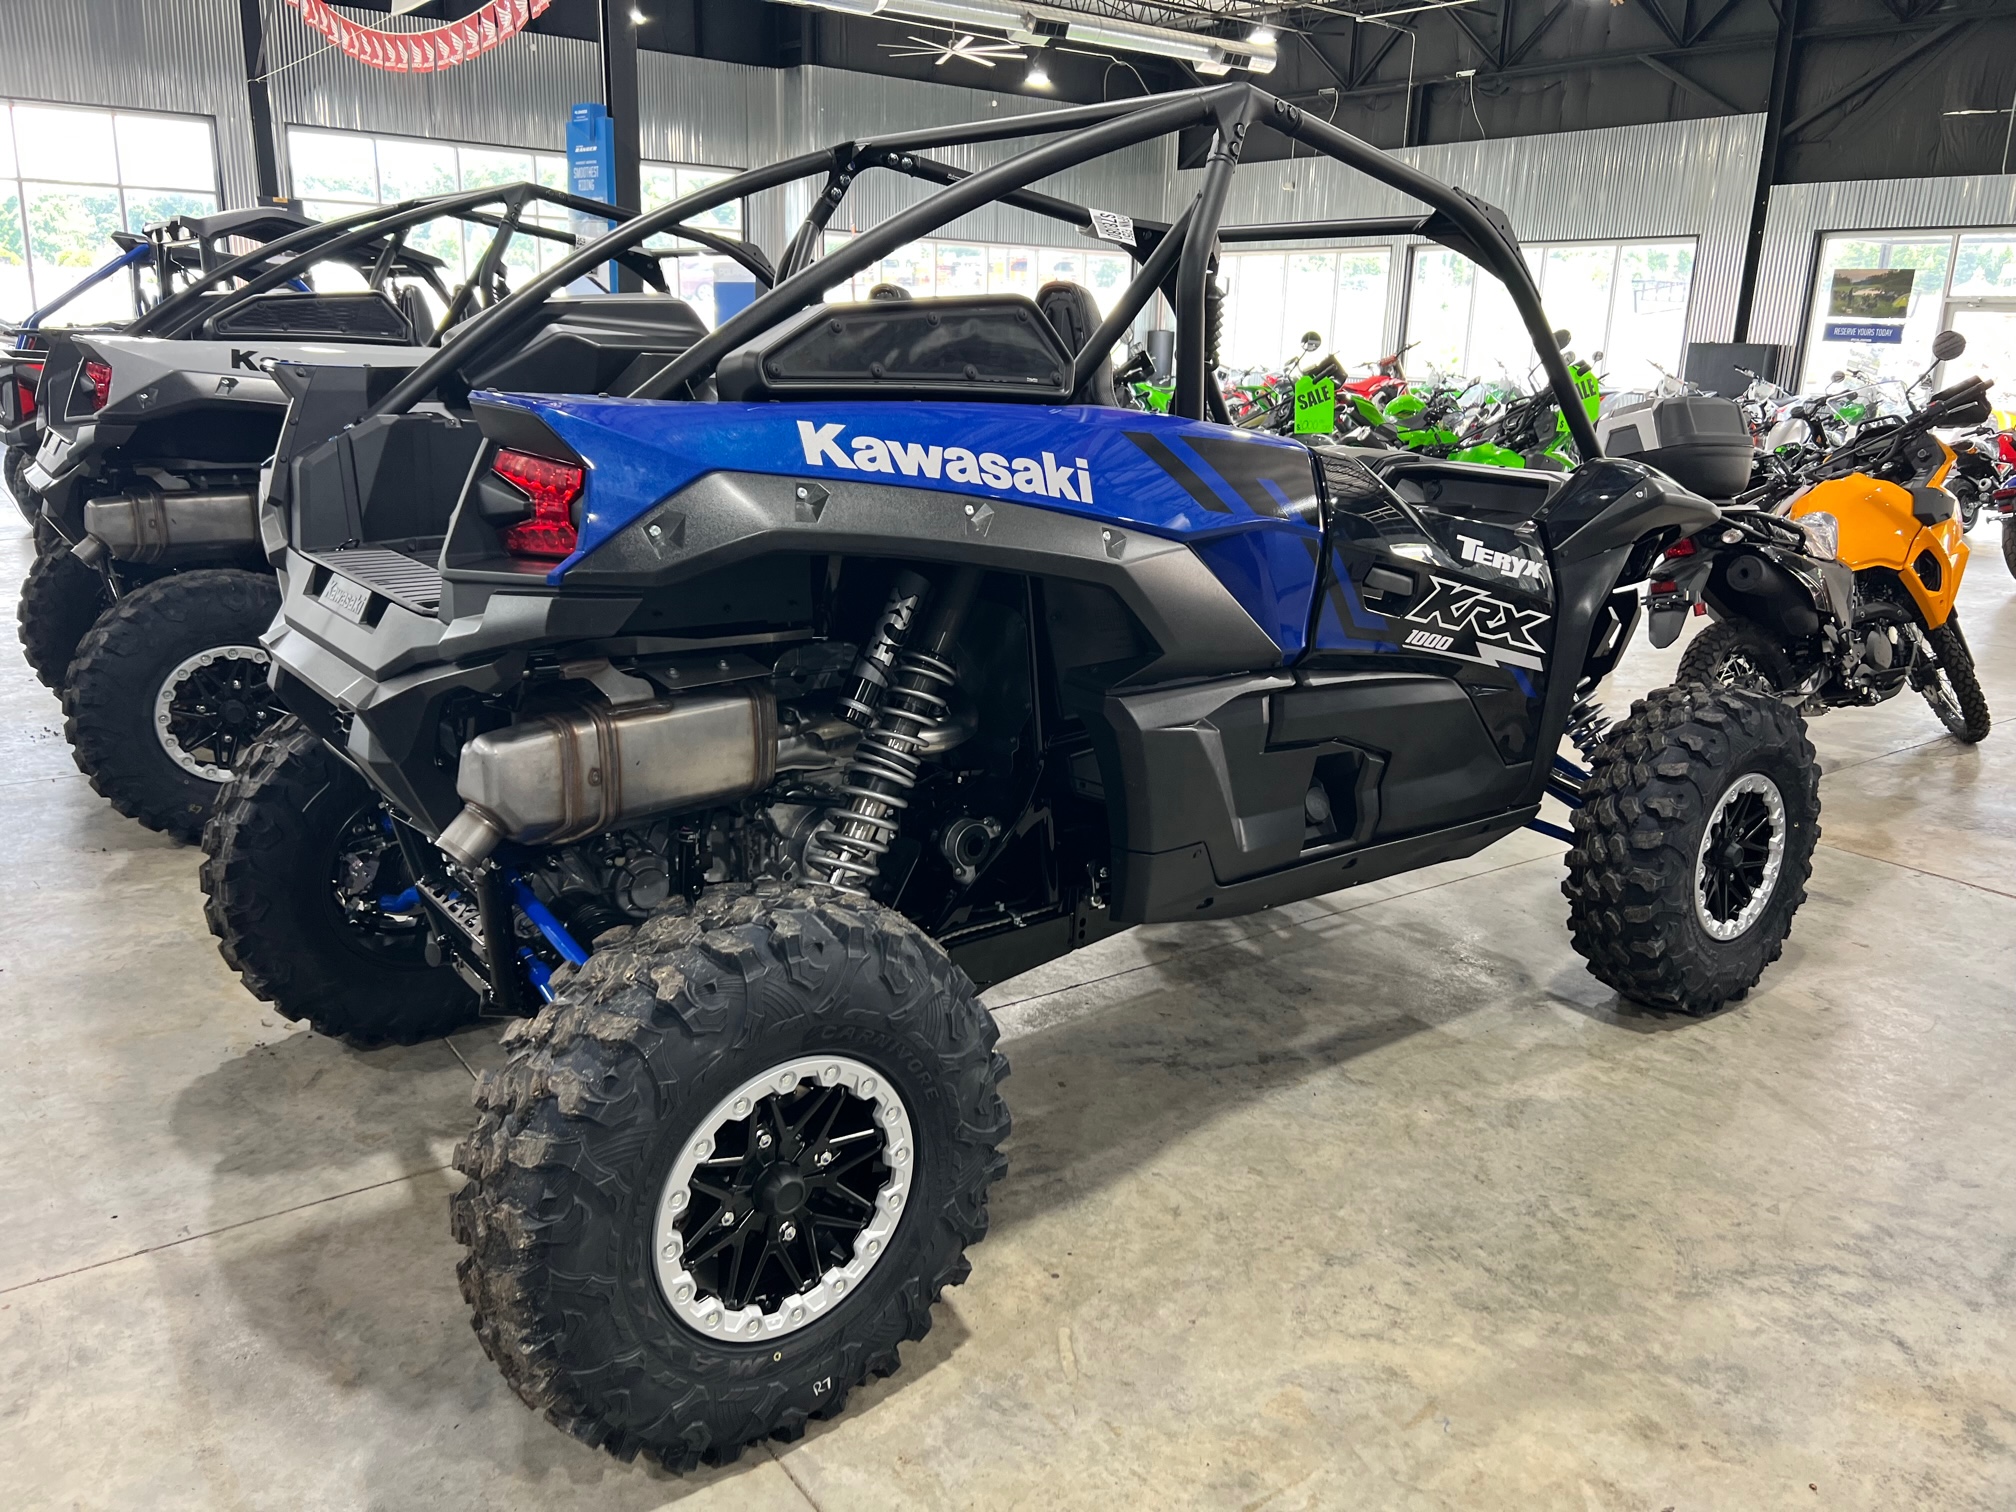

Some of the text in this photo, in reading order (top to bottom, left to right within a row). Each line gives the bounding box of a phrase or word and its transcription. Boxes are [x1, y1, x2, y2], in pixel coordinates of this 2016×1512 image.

[573, 166, 599, 179] SMOOTHEST
[1833, 327, 1893, 337] RESERVE YOURS TODAY
[1297, 385, 1331, 410] SALE
[1575, 378, 1597, 400] LE
[796, 420, 1094, 504] Kawasaki
[1456, 534, 1543, 579] TERYX
[325, 580, 367, 615] Kawasaki
[1404, 574, 1551, 654] KRX
[864, 586, 919, 668] FOX
[1405, 629, 1454, 650] 1000
[820, 1025, 940, 1102] CARNIVORE
